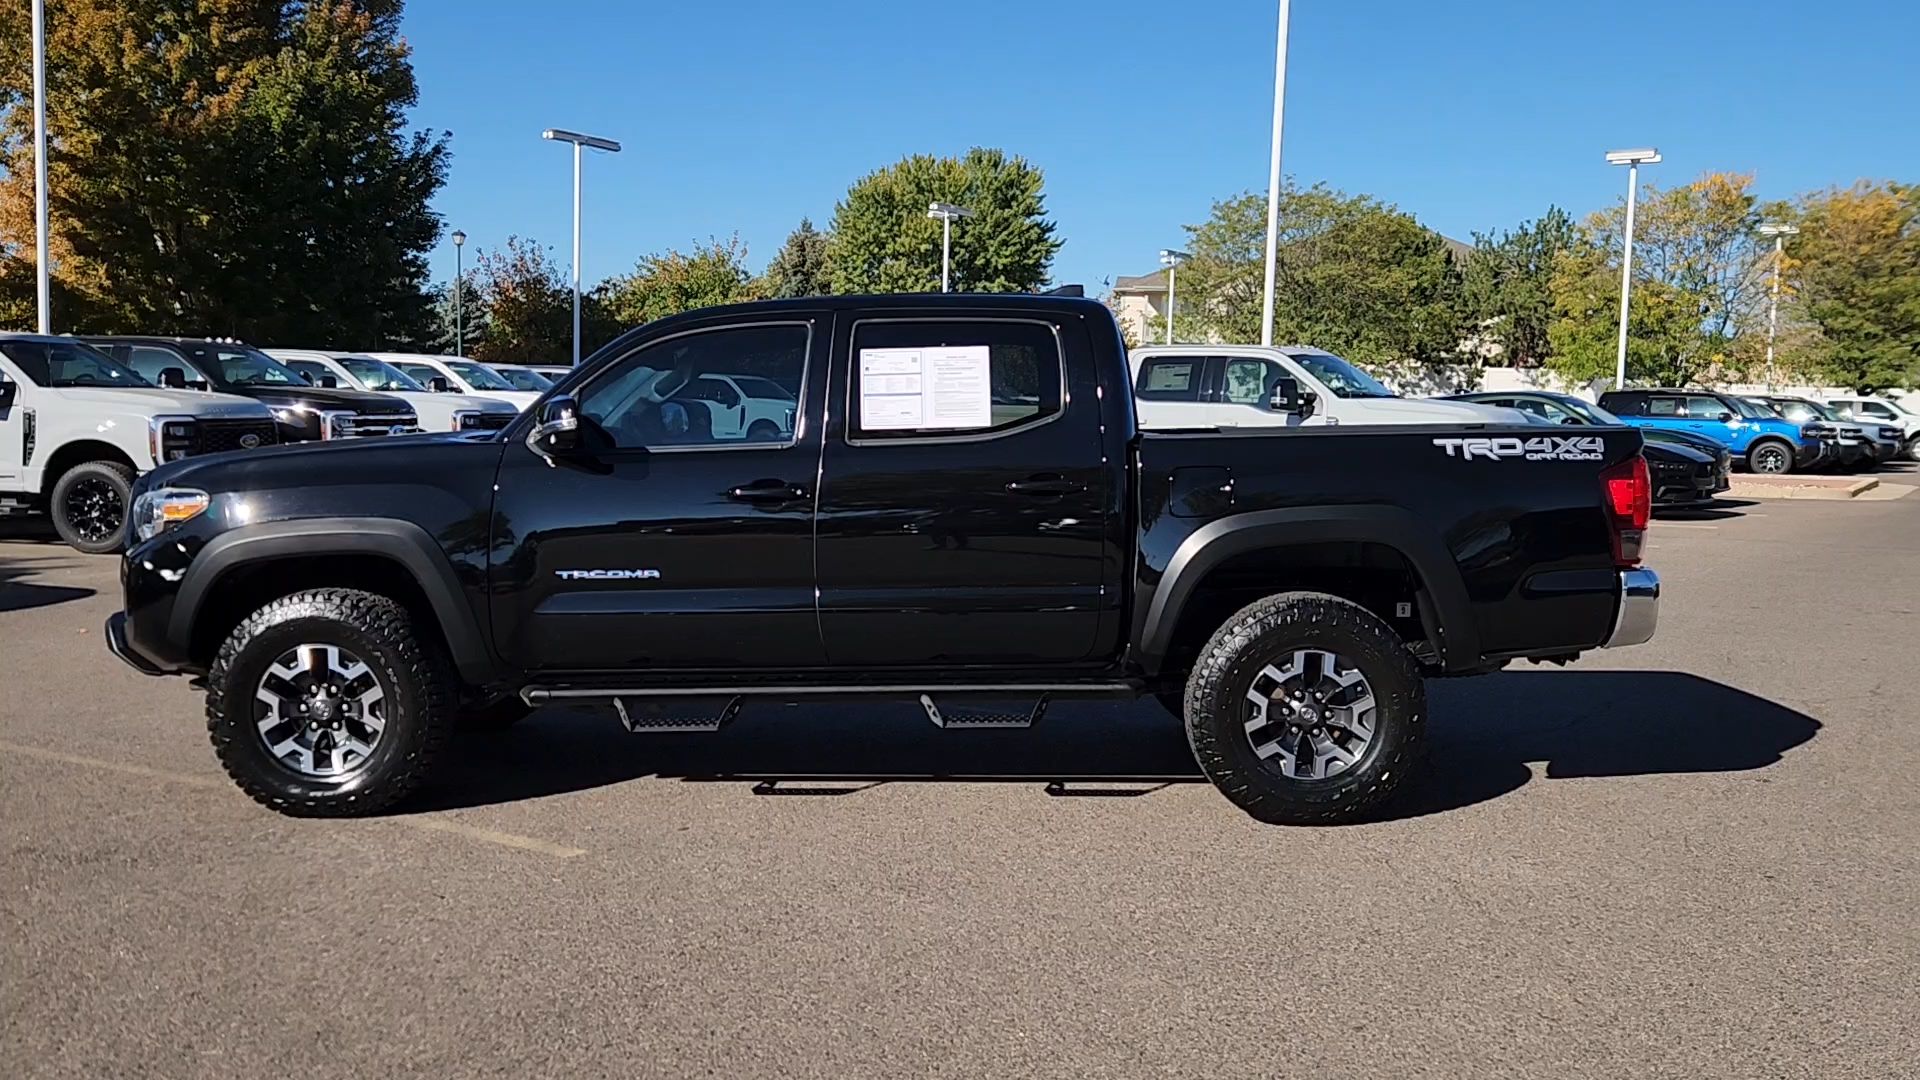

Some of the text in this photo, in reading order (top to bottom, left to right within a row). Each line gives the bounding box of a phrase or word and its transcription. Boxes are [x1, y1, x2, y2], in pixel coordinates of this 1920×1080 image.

[1433, 437, 1605, 460] TRD 4X4
[1525, 453, 1603, 461] OFF ROAD
[555, 569, 661, 580] TACOMA
